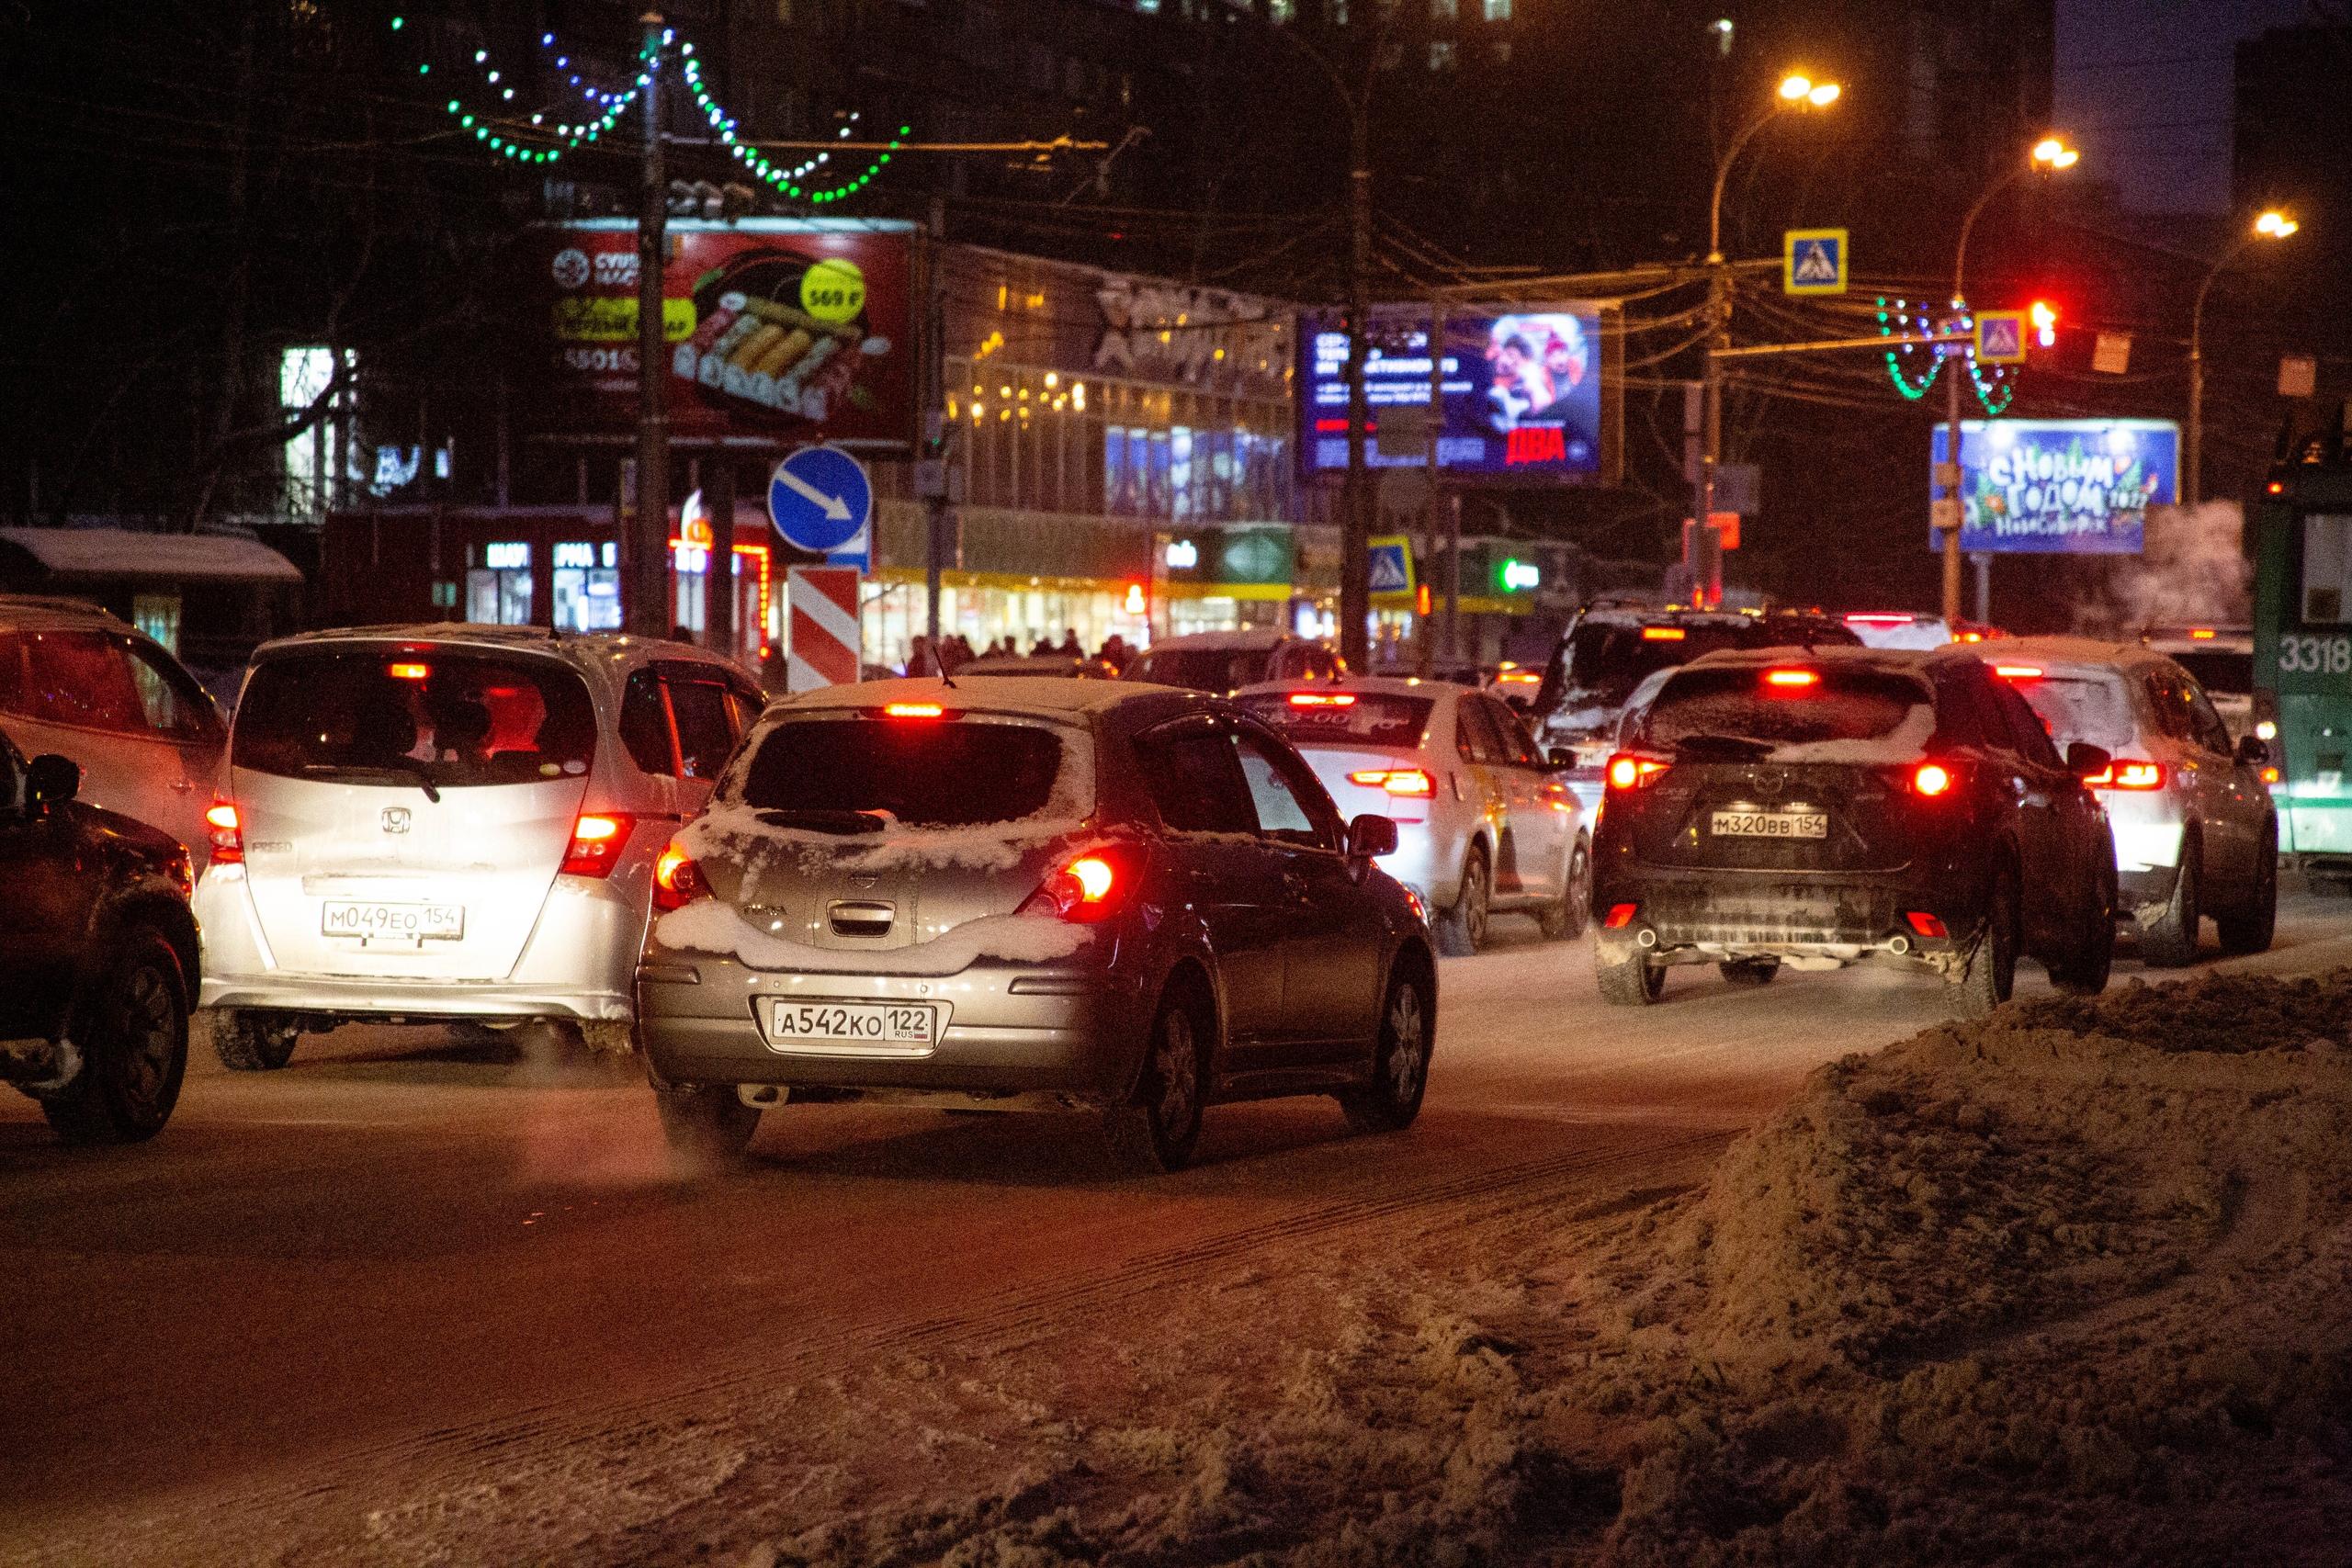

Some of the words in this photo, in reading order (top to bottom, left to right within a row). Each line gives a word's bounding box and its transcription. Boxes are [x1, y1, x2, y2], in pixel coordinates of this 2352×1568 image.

[1506, 426, 1566, 465] ДВА
[1989, 457, 2011, 486] С
[2011, 446, 2114, 489] НОВЫМ
[2007, 479, 2104, 518] ГОДОМ
[2278, 635, 2351, 673] 3318
[1716, 815, 1791, 834] М320ВВ
[1795, 816, 1824, 830] 154
[330, 907, 417, 930] М049ЕО
[424, 908, 455, 923] 154
[781, 1008, 882, 1036] А542КО
[888, 1010, 926, 1031] 122
[894, 1030, 913, 1039] RUS
